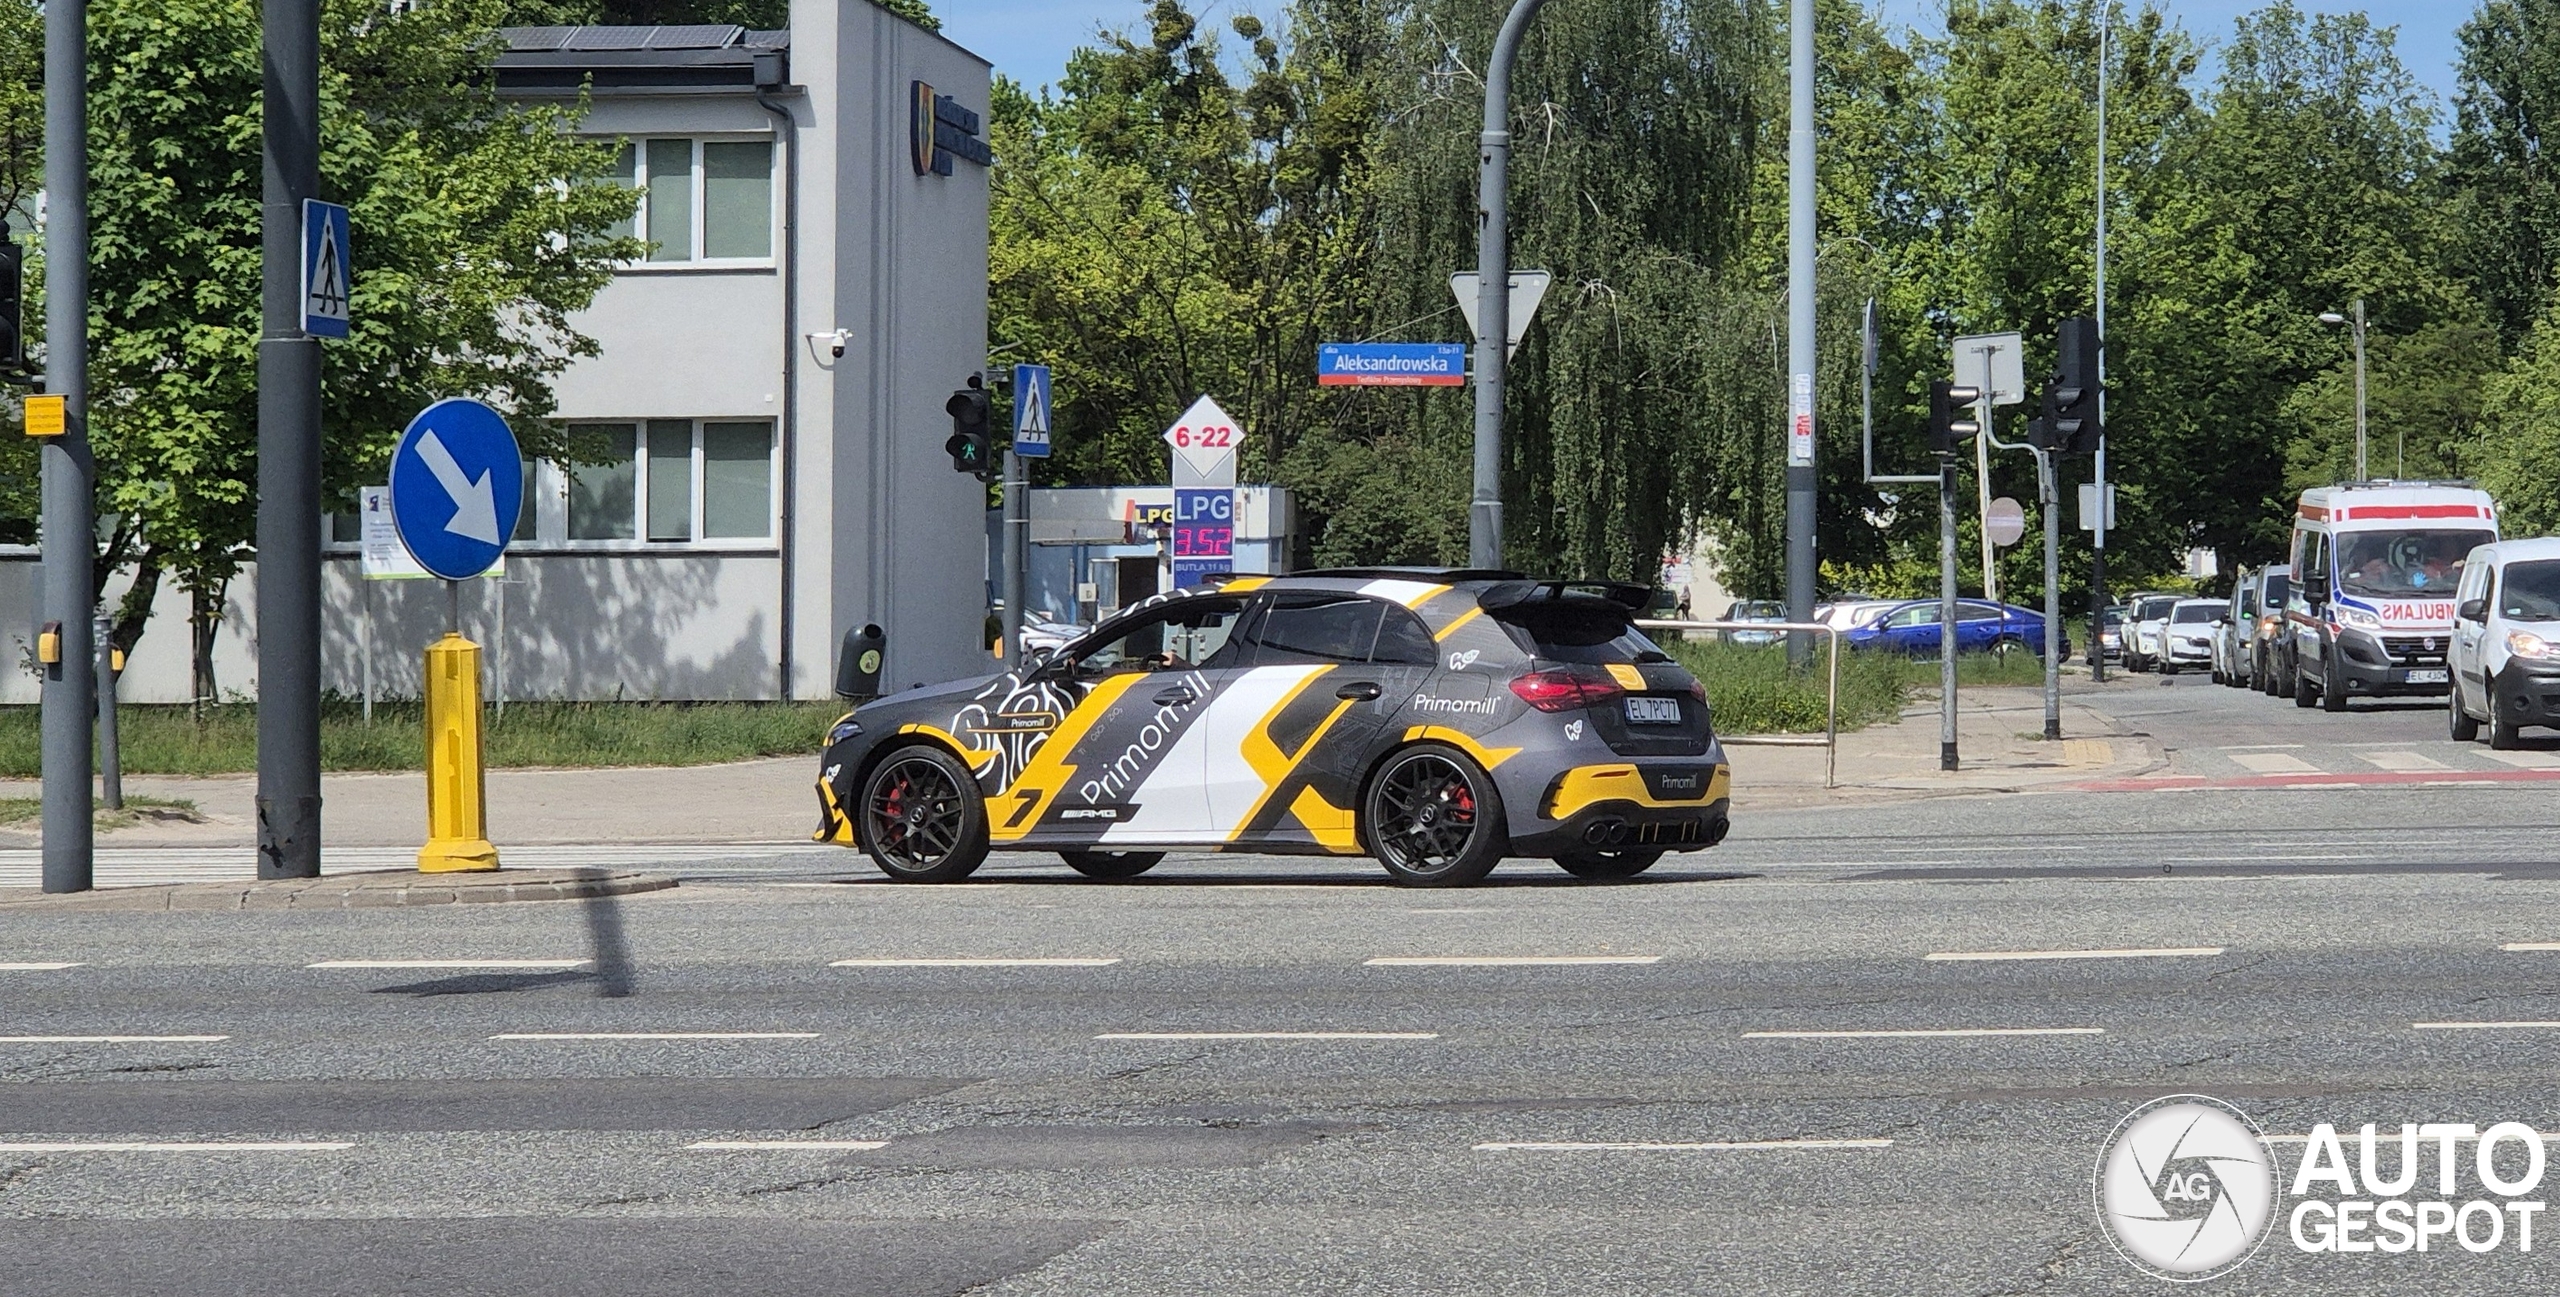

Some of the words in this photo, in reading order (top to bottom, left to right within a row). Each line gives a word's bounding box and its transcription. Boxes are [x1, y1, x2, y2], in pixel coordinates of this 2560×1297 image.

[1334, 354, 1448, 372] Aleksandrowska
[1175, 426, 1231, 448] 6-22
[1176, 495, 1230, 520] LPG
[1175, 528, 1232, 555] 3.52
[1175, 563, 1206, 571] BUTLA
[1413, 693, 1500, 715] Primomill
[1630, 699, 1646, 719] EL
[1646, 700, 1677, 720] 7PC77
[1079, 670, 1212, 805] Primomill
[1661, 773, 1698, 789] Primomill
[1002, 789, 1044, 828] 7
[1079, 809, 1117, 818] AMG
